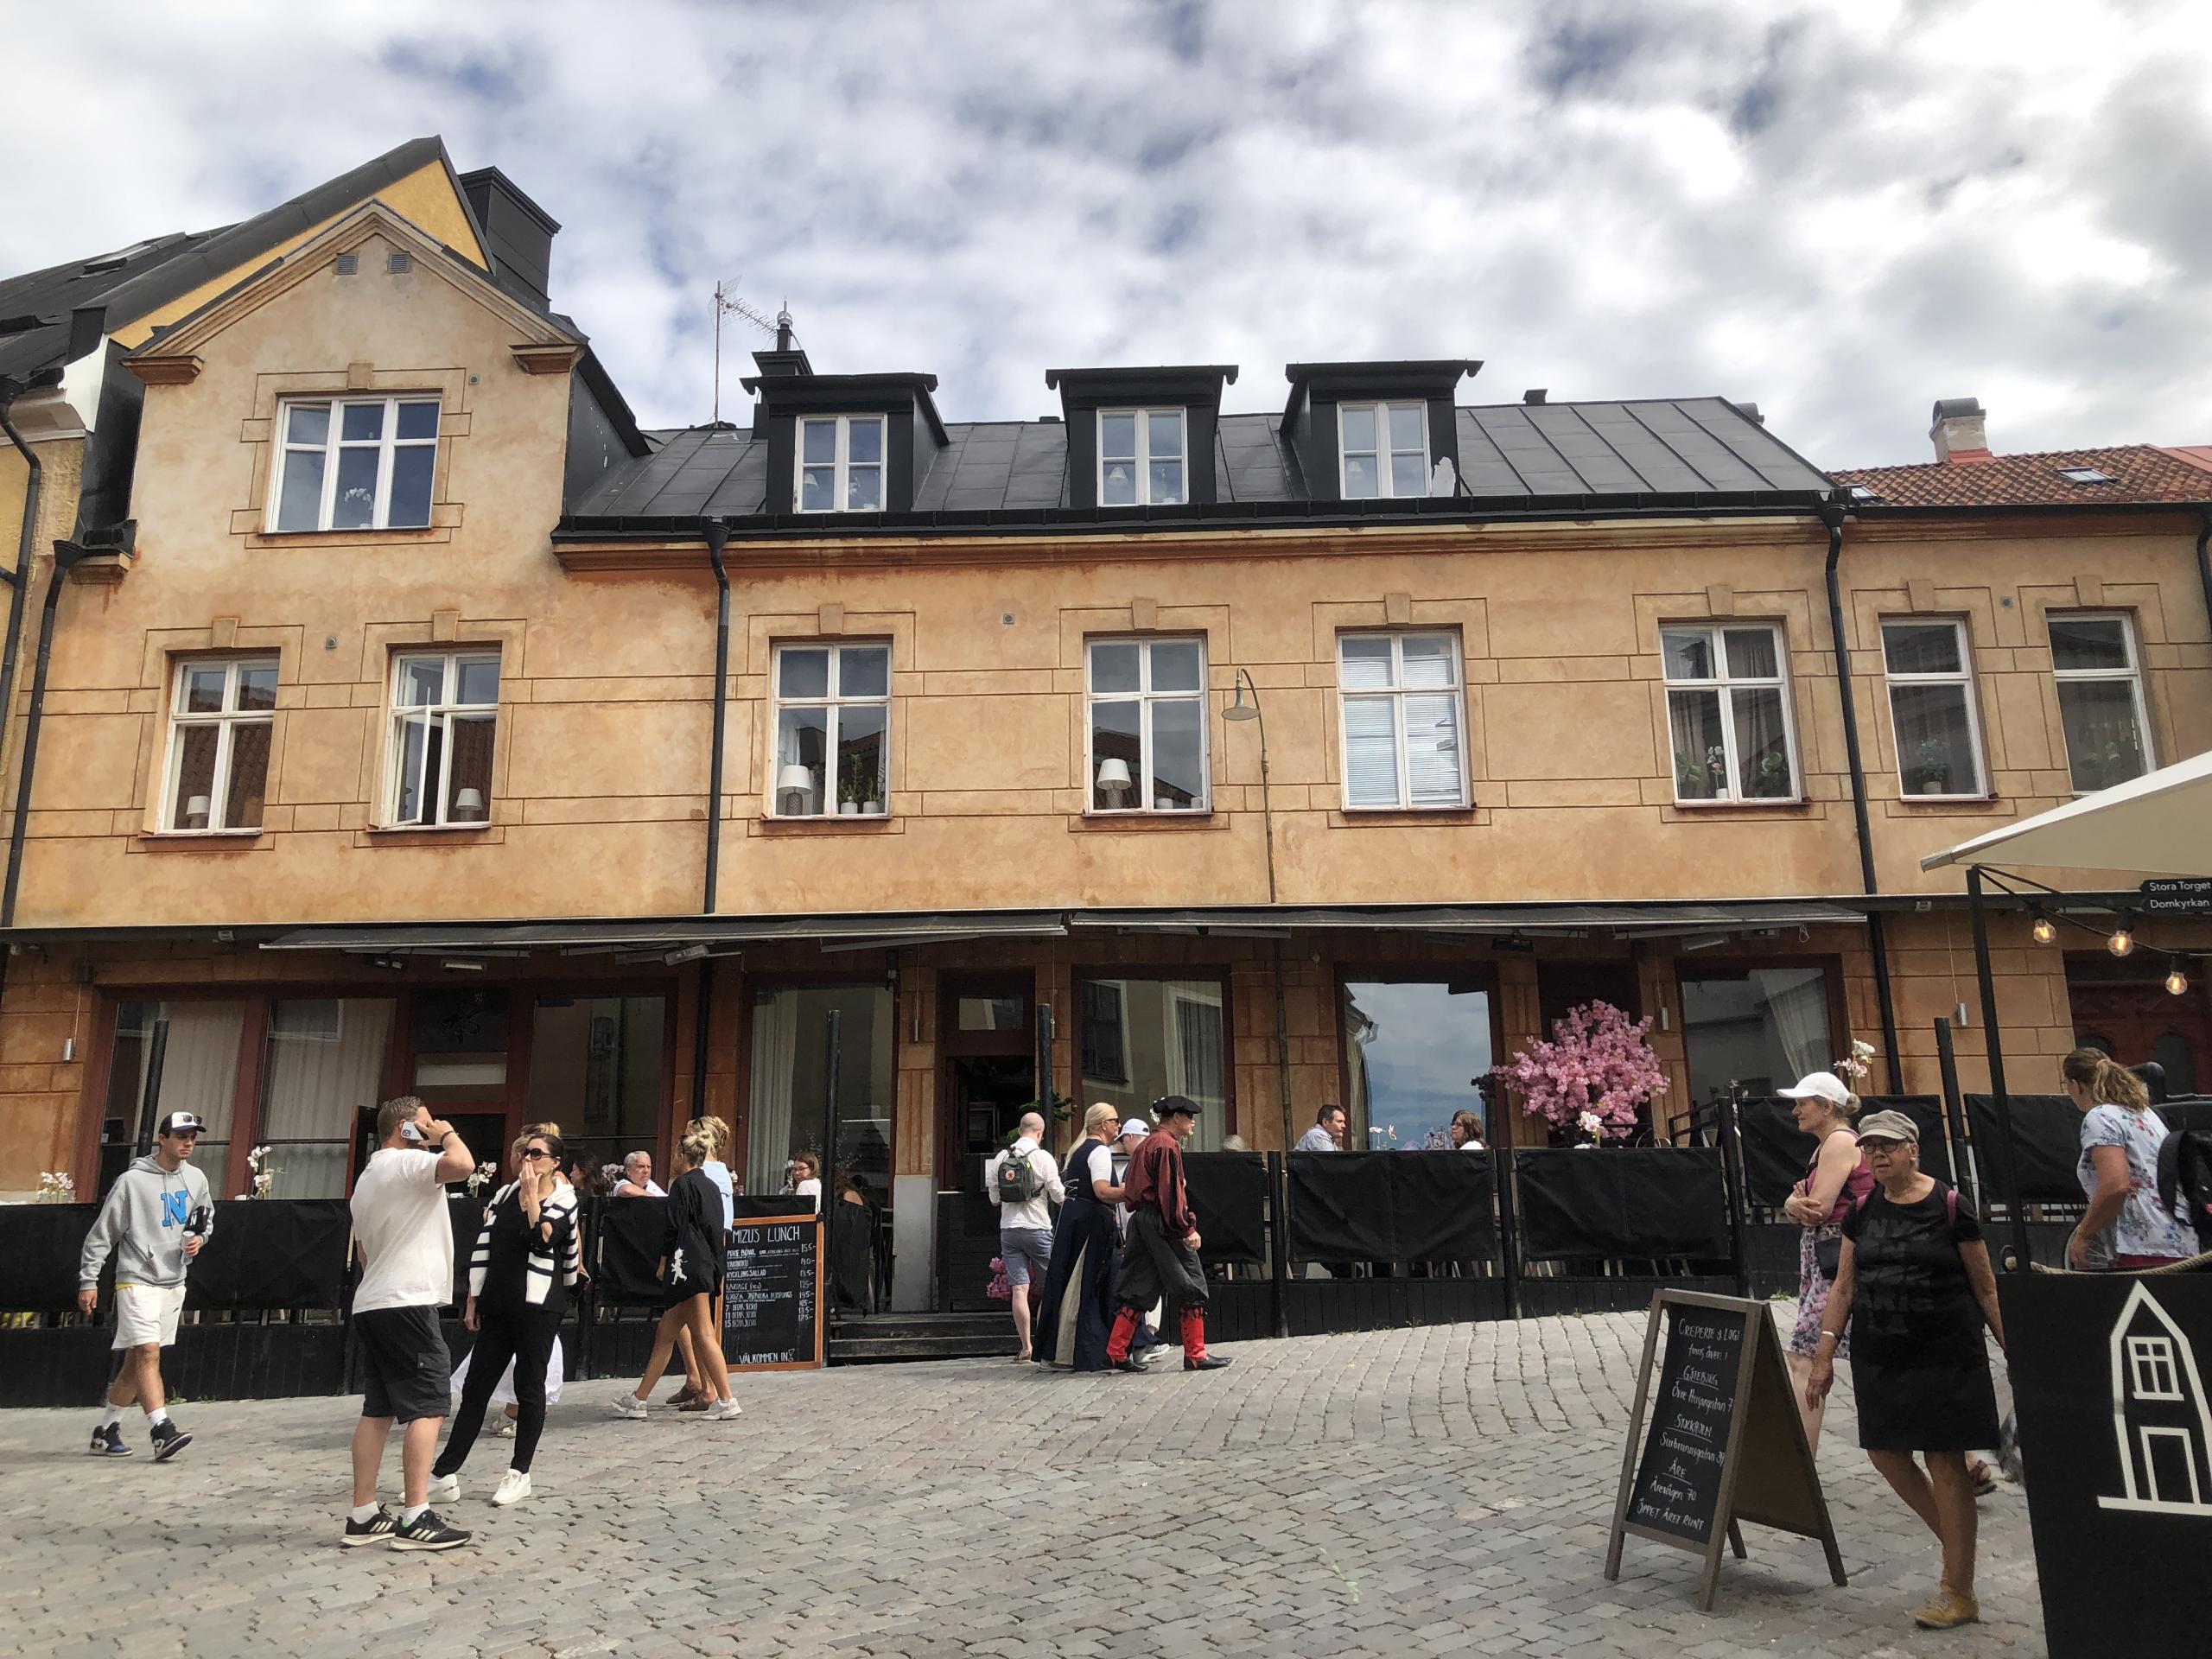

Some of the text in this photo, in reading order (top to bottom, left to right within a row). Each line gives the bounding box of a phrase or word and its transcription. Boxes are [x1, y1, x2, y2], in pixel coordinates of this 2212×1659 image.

[2149, 880, 2211, 893] Stora Torget
[2150, 898, 2210, 909] Domkyrkan
[161, 1190, 188, 1227] N
[767, 1225, 800, 1242] LUNCH
[1678, 1318, 1715, 1339] CREPERIE
[1724, 1328, 1740, 1341] LOGI
[739, 1352, 778, 1363] VÄLKOMMEN
[1683, 1364, 1719, 1386] GÖTEBORG
[1728, 1397, 1733, 1413] 7
[1674, 1413, 1713, 1438] STOCKHOLM
[1668, 1457, 1687, 1478] ÅRE
[1716, 1451, 1726, 1467] 39
[1687, 1487, 1697, 1501] 70
[1681, 1514, 1705, 1531] RUNT
